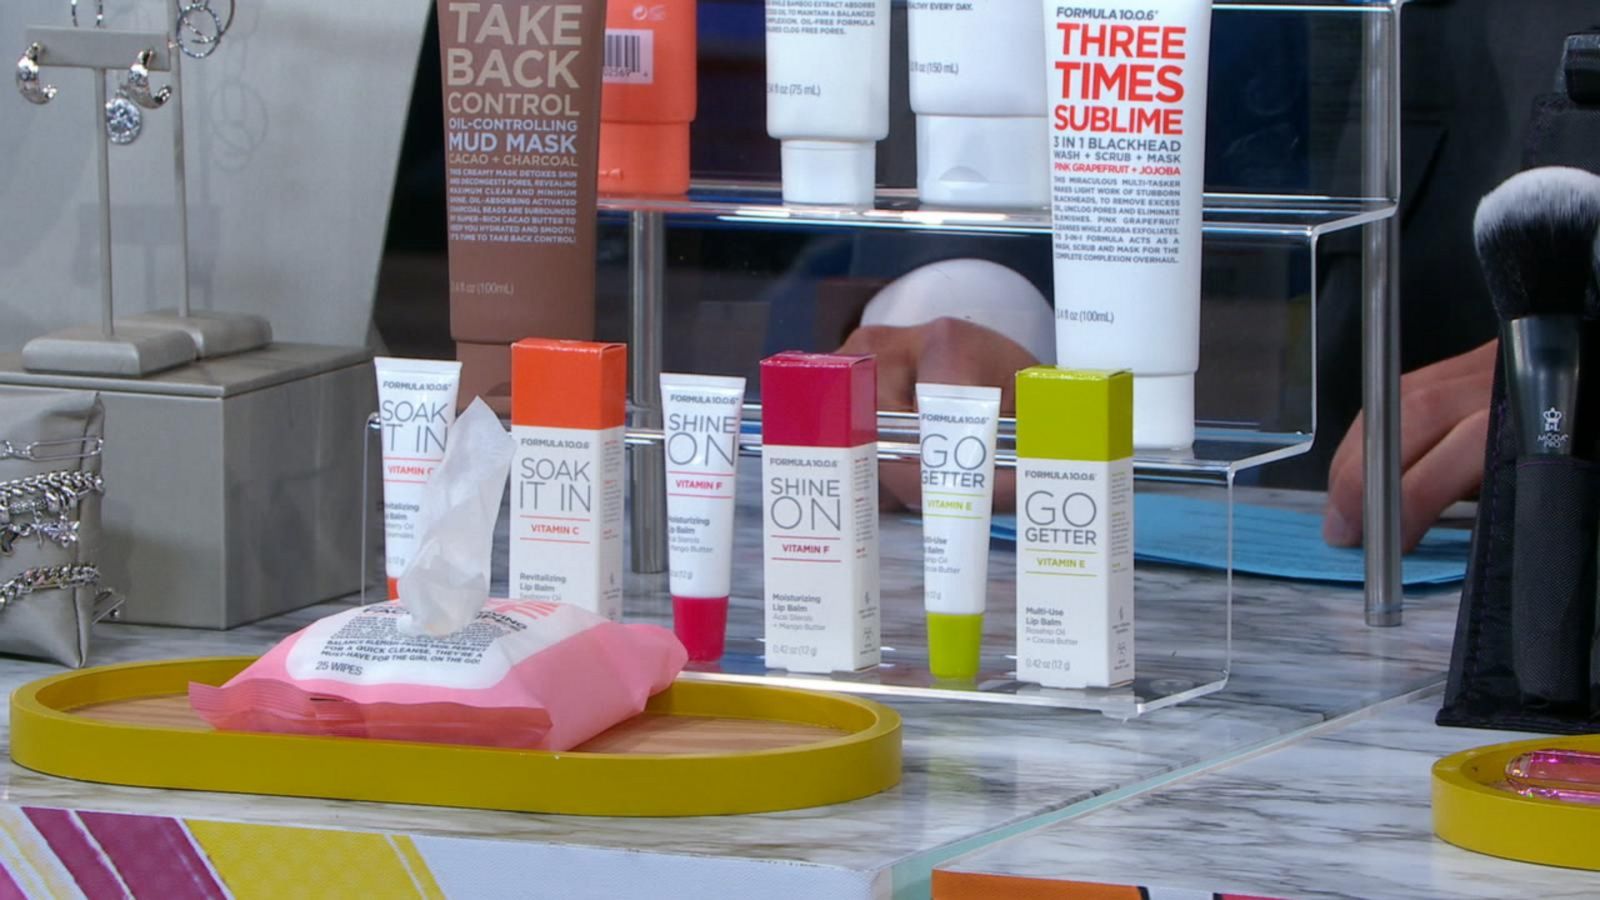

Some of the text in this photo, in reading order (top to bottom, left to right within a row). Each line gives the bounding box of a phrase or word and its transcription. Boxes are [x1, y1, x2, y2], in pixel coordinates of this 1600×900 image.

[929, 2, 954, 11] EVERY
[1056, 7, 1117, 20] FORMULA
[449, 3, 583, 46] TAKE
[1057, 22, 1187, 60] THREE
[447, 48, 580, 89] BACK
[1055, 61, 1185, 104] TIMES
[447, 92, 580, 116] CONTROL
[448, 118, 577, 132] OIL-CONTROLLING
[1054, 105, 1184, 135] SUBLIME
[449, 133, 577, 154] MUD MASK
[1062, 137, 1075, 149] IN
[1088, 138, 1181, 152] BLACKHEAD
[449, 153, 489, 165] CACAO
[503, 155, 579, 167] CHARCOAL
[1054, 151, 1080, 161] WASH
[1095, 152, 1131, 162] SCRUB
[1147, 154, 1181, 164] MASK
[1072, 163, 1129, 174] GRAPEFRUIT
[1139, 166, 1181, 176] JOJOBA
[1069, 177, 1181, 187] MIRACULOUS MULTI-TASKER
[1074, 186, 1095, 194] LIGHT
[1097, 187, 1121, 195] WORK
[1136, 189, 1181, 197] STUBBORN
[1113, 198, 1146, 206] REMOVE
[1148, 199, 1181, 207] EXCESS
[1092, 206, 1117, 214] PORES
[1118, 207, 1136, 215] AND
[1137, 208, 1180, 216] ELIMINATE
[1123, 217, 1180, 225] GRAPEFRUIT
[1103, 226, 1130, 234] JOJOBA
[510, 235, 532, 243] BACK
[1086, 235, 1124, 243] FORMULA
[1129, 236, 1151, 244] ACTS
[1156, 237, 1168, 245] AS
[1072, 244, 1096, 252] SCRUB
[1097, 245, 1115, 253] AND
[1116, 246, 1140, 254] MASK
[1163, 247, 1179, 255] THE
[382, 381, 425, 391] FORMULA
[670, 394, 712, 404] FORMULA
[381, 400, 448, 425] SOAK
[668, 413, 737, 434] SHINE
[921, 413, 964, 424] FORMULA
[415, 425, 449, 454] IN
[520, 438, 564, 449] FORMULA
[667, 432, 736, 467] ON
[920, 433, 987, 471] GO
[769, 457, 811, 467] FORMULA
[387, 466, 425, 475] VITAMIN
[520, 457, 591, 483] SOAK
[1024, 470, 1069, 480] FORMULA
[921, 470, 985, 488] GETTER
[675, 480, 713, 490] VITAMIN
[770, 477, 841, 498] SHINE
[519, 480, 591, 513] IT IN
[927, 500, 964, 511] VITAMIN
[1025, 489, 1097, 528] GO
[770, 495, 841, 531] ON
[530, 524, 580, 535] VITAMIN C
[1024, 527, 1097, 545] GETTER
[782, 544, 830, 554] VITAMIN F
[1037, 557, 1087, 568] VITAMIN E
[519, 573, 567, 584] Revitalizing
[519, 583, 555, 593] Lip Balm
[772, 593, 822, 604] Moisturizing
[772, 604, 786, 613] Lip
[1025, 607, 1064, 616] Multi-Use
[1025, 617, 1062, 626] Lip Balm
[355, 645, 386, 654] QUICK
[315, 660, 364, 676] 25 WIPES
